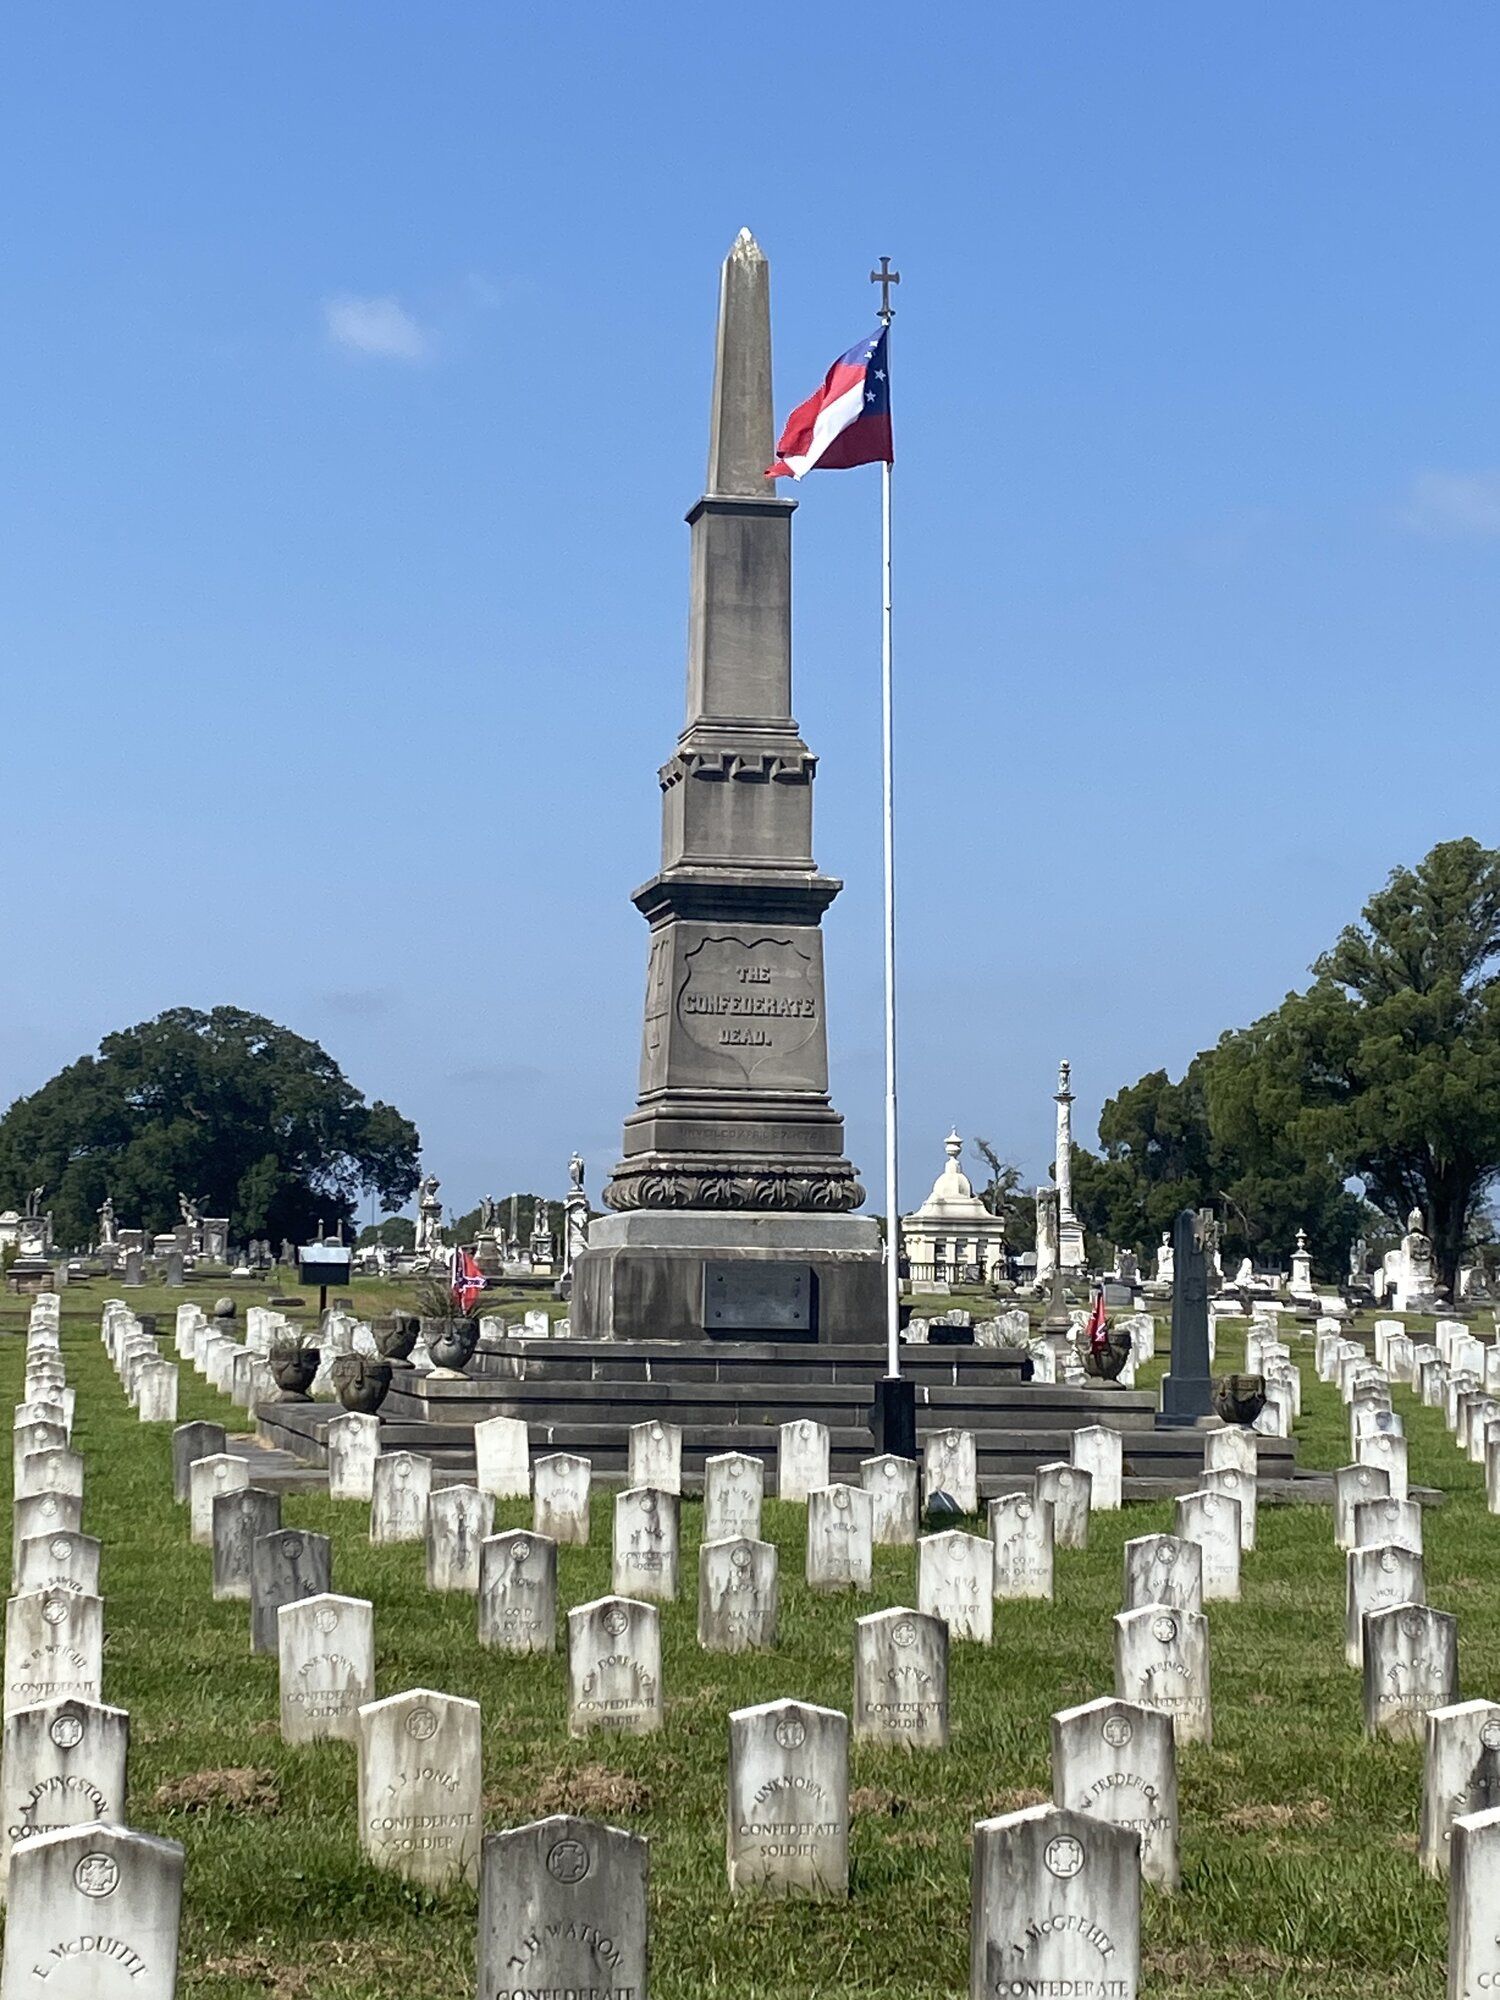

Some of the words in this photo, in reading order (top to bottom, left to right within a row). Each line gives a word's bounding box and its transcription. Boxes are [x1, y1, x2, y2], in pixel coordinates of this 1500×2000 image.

[737, 965, 771, 984] THE
[684, 995, 816, 1018] CONFEDERATE
[718, 1028, 772, 1047] DEAD.
[10, 1681, 95, 1695] CONFEDERATE
[286, 1687, 370, 1703] CONFEDERATE
[305, 1705, 352, 1718] SOLDIER
[577, 1697, 657, 1711] CONFEDERATE
[865, 1702, 943, 1713] CONFEDERATE
[883, 1718, 929, 1729] SOLDIER
[414, 1767, 461, 1793] JONES
[28, 1776, 110, 1816] LIVINGSTON
[753, 1775, 827, 1805] UNKNOWN
[1090, 1772, 1161, 1806] FREDERICK
[370, 1813, 476, 1832] CONFEDERATE
[739, 1822, 841, 1837] CONFEDERATE
[393, 1836, 455, 1851] SOLDIER
[759, 1844, 819, 1858] SOLDIER
[544, 1922, 626, 1970] WATSON
[32, 1964, 50, 1980] E
[495, 1986, 638, 2000] CONFEDERATE
[994, 1979, 1130, 1999] CONFEDERATE
